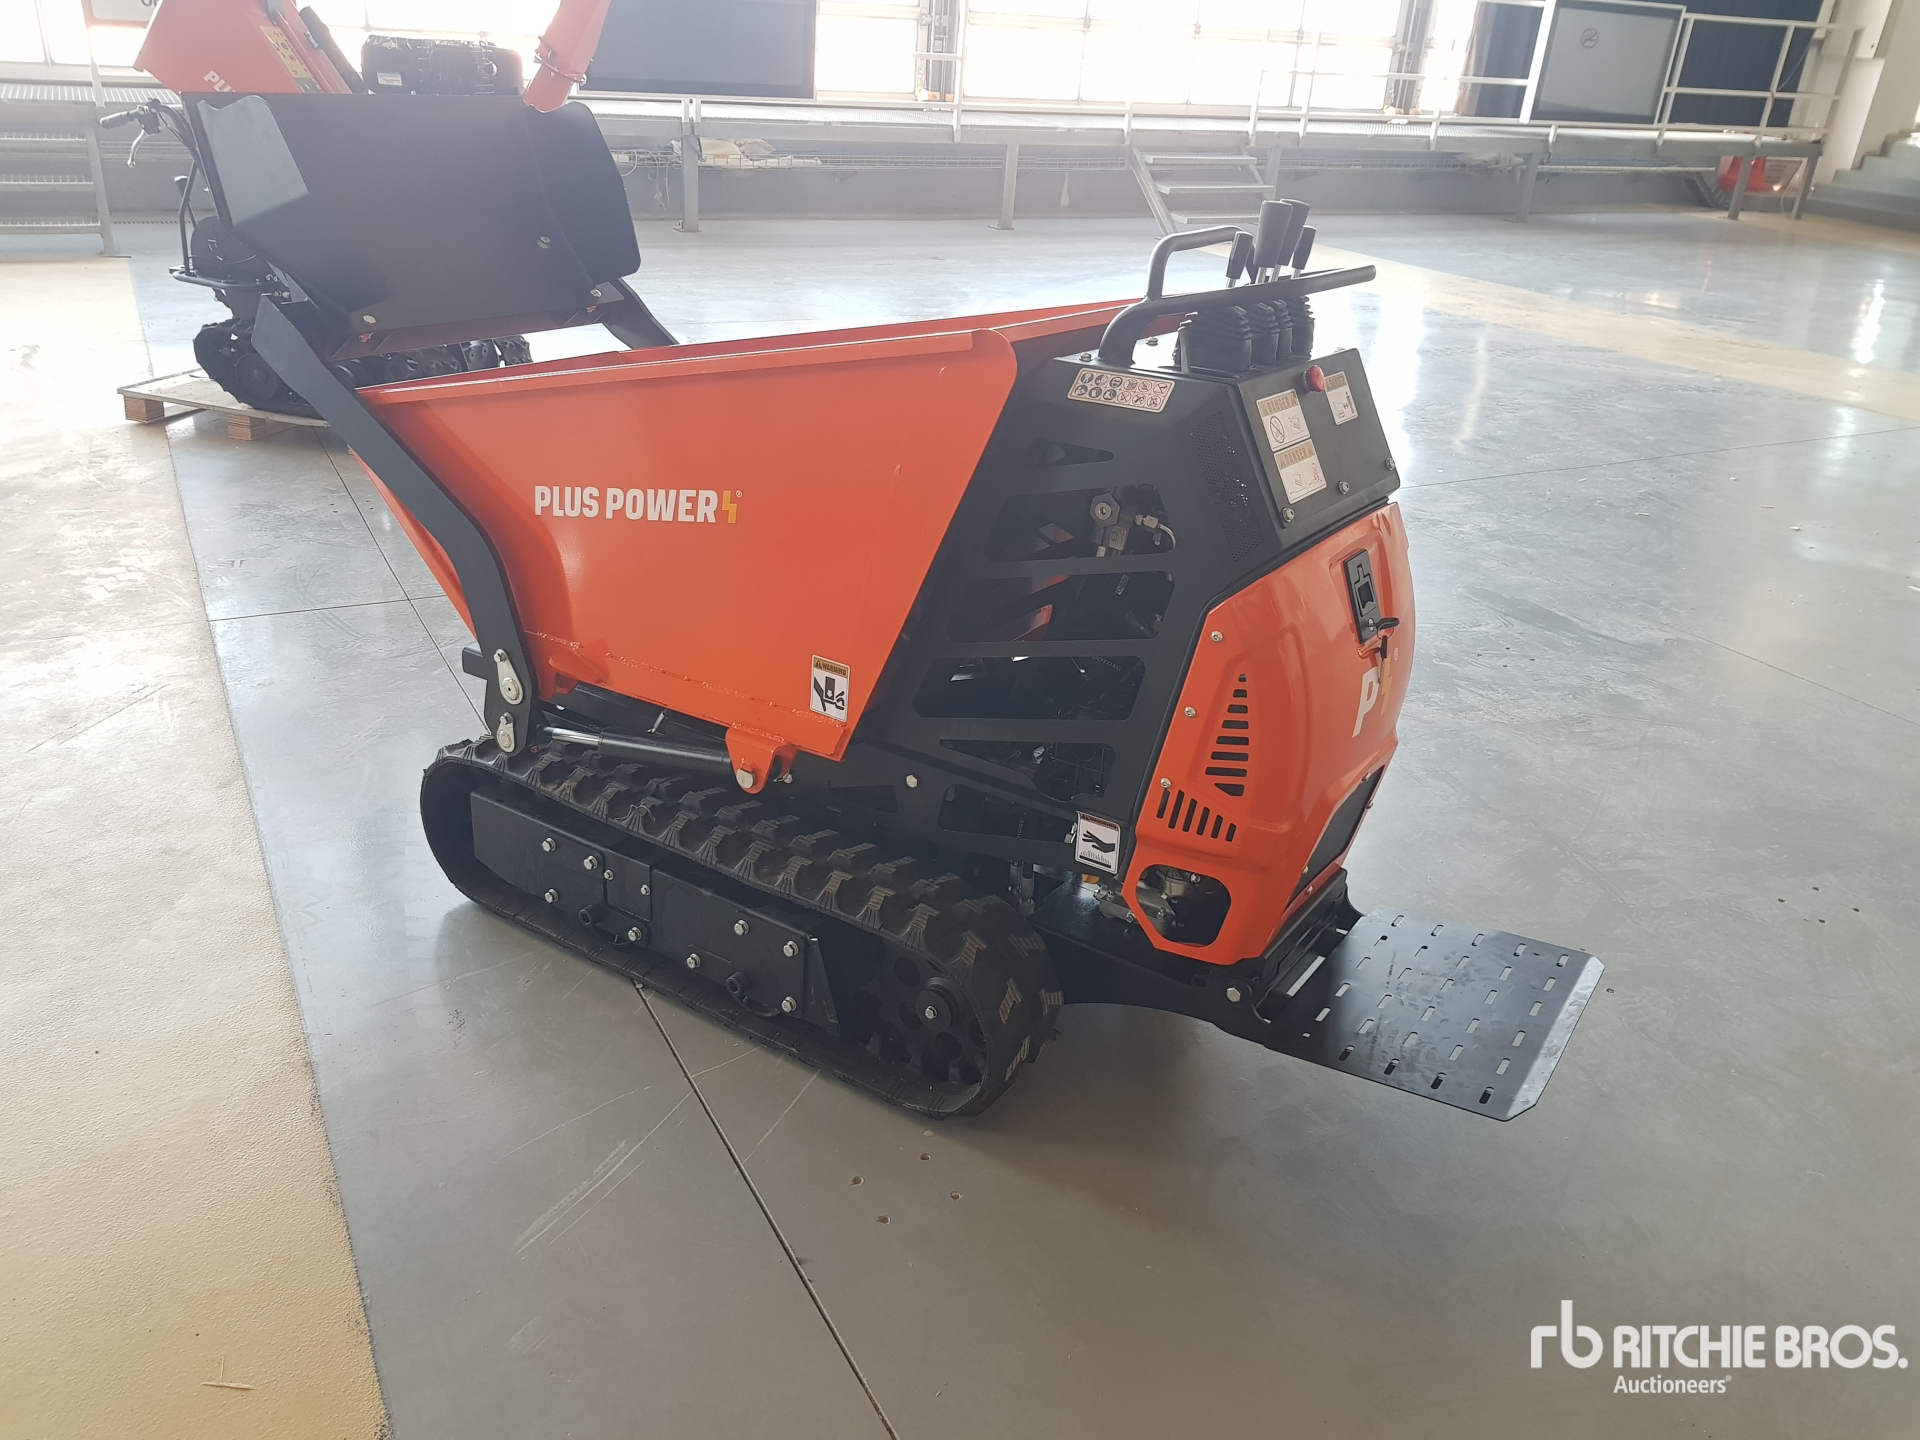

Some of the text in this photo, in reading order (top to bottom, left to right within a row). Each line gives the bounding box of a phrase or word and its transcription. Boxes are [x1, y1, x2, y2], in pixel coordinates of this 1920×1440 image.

[1267, 396, 1291, 413] DANGER
[1284, 446, 1308, 466] DANGER
[534, 485, 719, 524] PLUS POWER
[822, 662, 846, 676] WARNING
[1352, 666, 1381, 739] P
